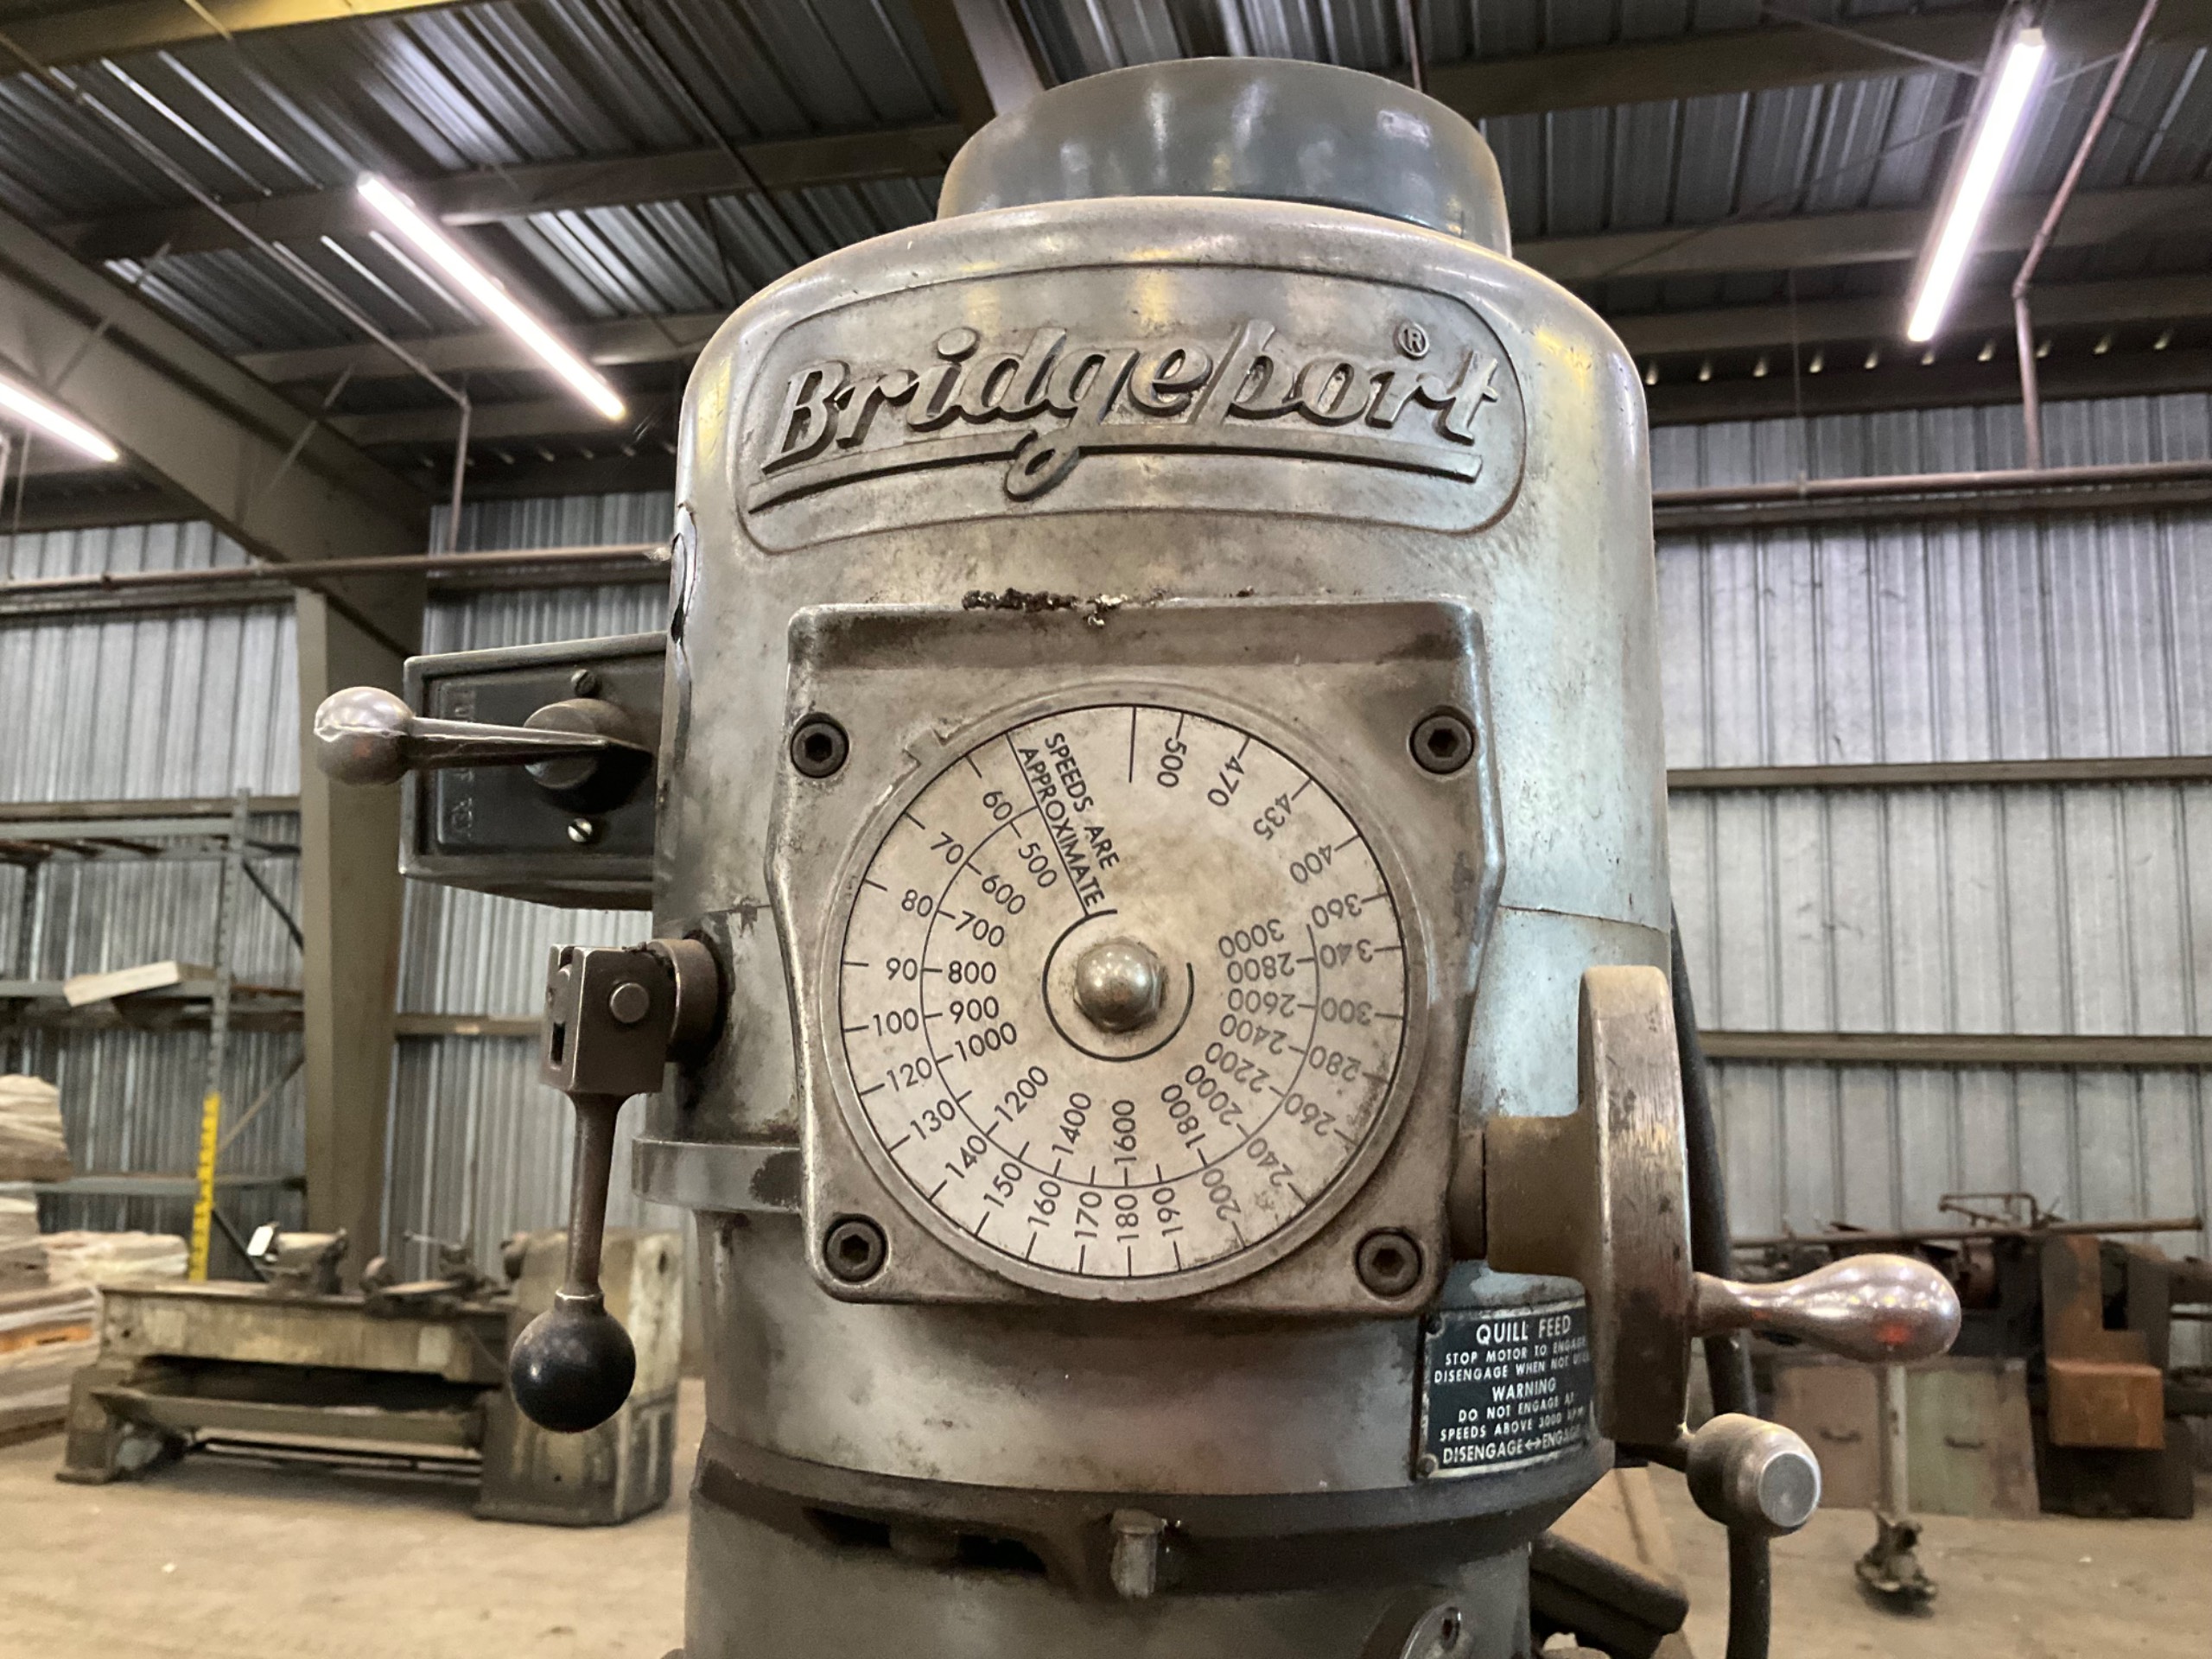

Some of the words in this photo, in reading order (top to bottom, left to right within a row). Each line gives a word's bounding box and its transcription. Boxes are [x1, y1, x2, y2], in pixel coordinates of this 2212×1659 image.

[761, 318, 1500, 503] Bridgeport
[1157, 737, 1187, 788] 500
[1207, 755, 1244, 806] 470
[982, 790, 1013, 822] 60
[1045, 732, 1094, 813] SPEEDS
[1084, 825, 1120, 870] ARE
[1253, 793, 1293, 841] 435
[1019, 747, 1105, 907] APPROXIMATE
[931, 831, 964, 865] 70
[1018, 842, 1058, 888] 500
[1289, 844, 1332, 885] 400
[901, 888, 934, 918] 80
[981, 874, 1026, 915] 600
[1312, 893, 1363, 929] 360
[955, 910, 1005, 948] 700
[1218, 918, 1285, 958] 3000
[886, 957, 918, 982] 90
[948, 960, 997, 984] 800
[1227, 951, 1295, 984] 2800
[1319, 938, 1373, 969] 340
[873, 1007, 919, 1037] 100
[950, 995, 1000, 1025] 900
[1227, 988, 1296, 1019] 2600
[1320, 997, 1372, 1027] 300
[954, 1021, 1018, 1062] 1000
[1219, 1014, 1287, 1056] 2400
[886, 1057, 933, 1091] 120
[1205, 1042, 1270, 1094] 2200
[1308, 1046, 1361, 1082] 280
[994, 1065, 1049, 1122] 1200
[1185, 1065, 1243, 1127] 2000
[910, 1099, 956, 1141] 130
[1052, 1091, 1092, 1155] 1400
[1112, 1099, 1137, 1166] 1600
[1160, 1084, 1205, 1149] 1800
[1284, 1092, 1336, 1137] 260
[945, 1135, 988, 1179] 140
[1247, 1138, 1294, 1188] 240
[983, 1161, 1023, 1208] 150
[1027, 1180, 1062, 1227] 160
[1201, 1168, 1242, 1221] 200
[1074, 1191, 1103, 1239] 170
[1115, 1193, 1140, 1243] 180
[1152, 1187, 1184, 1237] 190
[1476, 1320, 1529, 1345] QUILL
[1538, 1314, 1571, 1338] FEED
[1434, 1364, 1508, 1384] DISENGAGE
[1516, 1358, 1545, 1376] WHEN
[1551, 1355, 1568, 1370] NOT
[1445, 1351, 1478, 1366] STOP
[1485, 1346, 1528, 1363] MOTOR
[1535, 1344, 1547, 1357] TO
[1459, 1408, 1478, 1424] DO
[1486, 1404, 1511, 1420] NOT
[1517, 1394, 1560, 1415] ENGAGE
[1491, 1376, 1557, 1402] WARNING
[1440, 1424, 1487, 1442] SPEEDS
[1494, 1418, 1533, 1436] ABOVE
[1538, 1412, 1562, 1427] 3000
[1443, 1438, 1523, 1465] DISENGAGE
